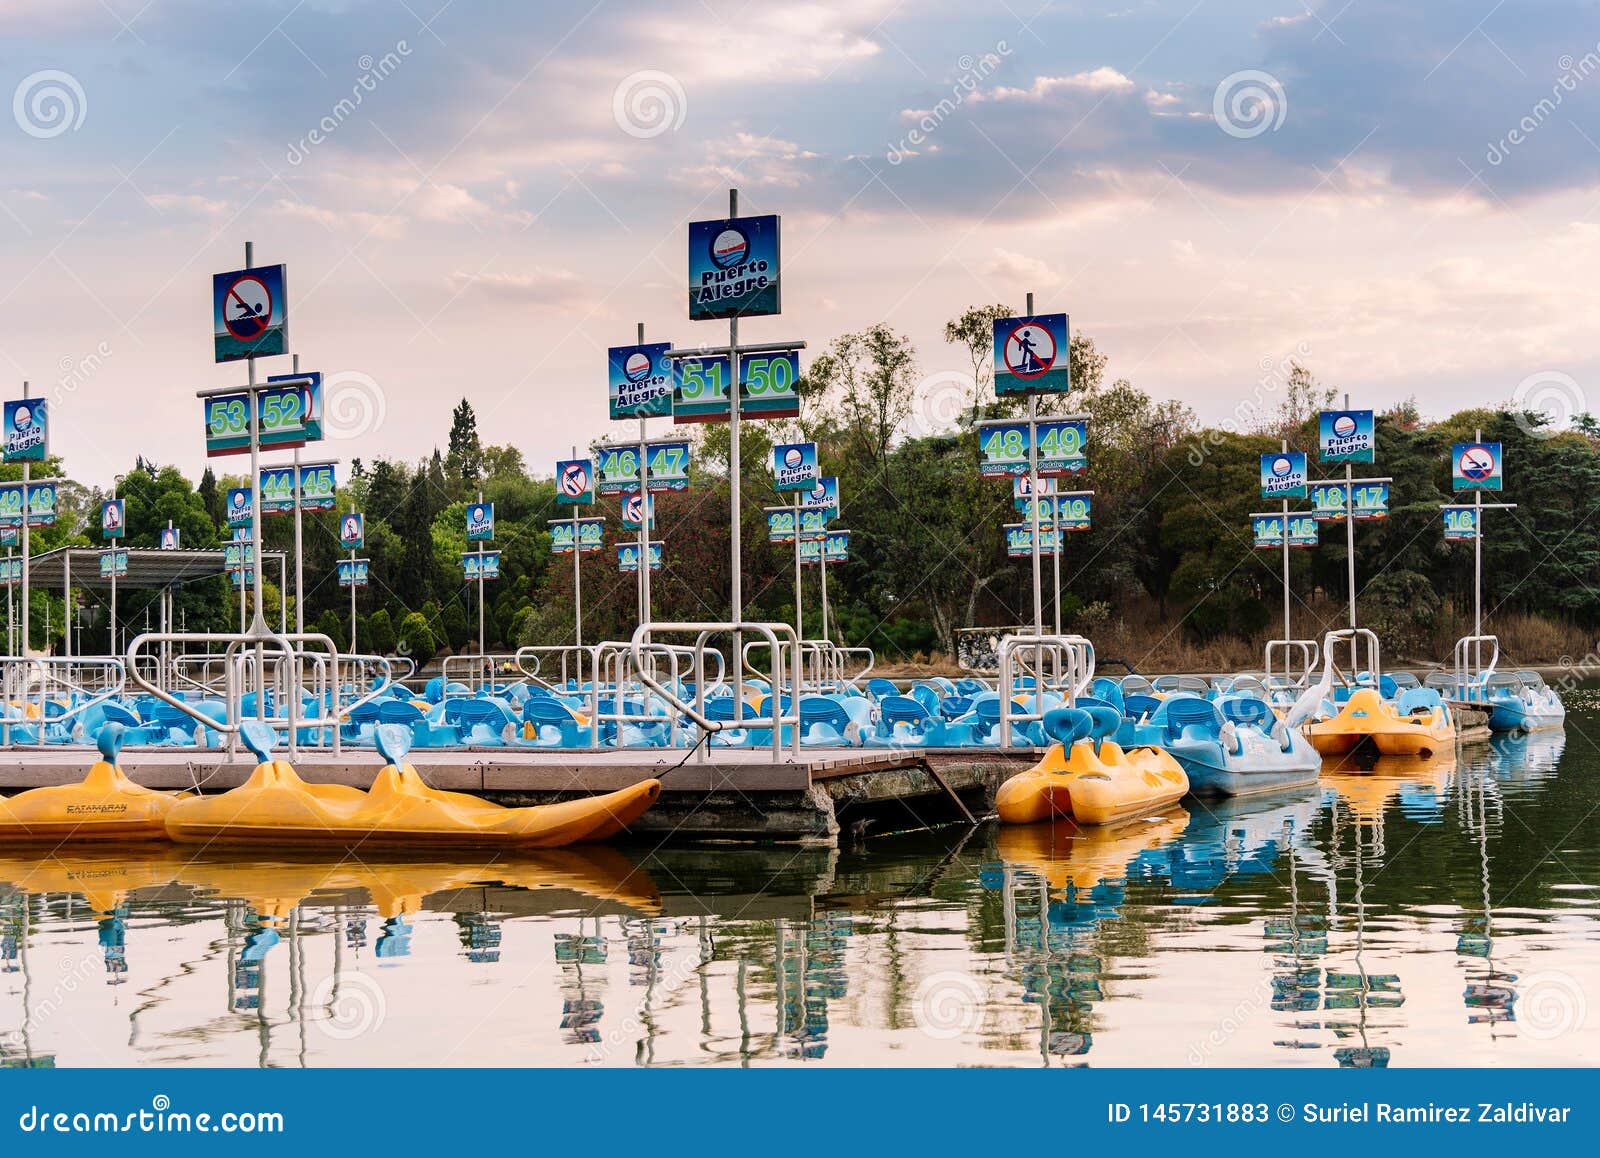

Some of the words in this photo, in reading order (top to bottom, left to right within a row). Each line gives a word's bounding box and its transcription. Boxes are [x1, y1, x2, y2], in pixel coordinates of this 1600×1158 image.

[701, 259, 768, 286] Puerto
[697, 274, 768, 304] Alegre
[617, 374, 665, 395] Puerto
[681, 362, 721, 399] 51
[746, 358, 792, 395] 50
[615, 385, 666, 409] Alegre
[210, 400, 247, 434] 53
[263, 394, 300, 428] 52
[9, 426, 42, 443] Puerto
[985, 430, 1024, 458] 48
[1041, 427, 1080, 456] 49
[1327, 434, 1368, 447] Puerto
[8, 436, 42, 454] Alegre
[1325, 441, 1368, 457] Alegre
[603, 451, 636, 477] 46
[651, 448, 684, 475] 47
[780, 464, 812, 477] Puerto
[263, 473, 291, 498] 44
[302, 470, 332, 496] 45
[779, 472, 812, 486] Alegre
[1266, 479, 1302, 492] Alegre
[1267, 473, 1301, 485] Puerto
[0, 490, 20, 513] 42
[30, 487, 52, 511] 43
[807, 496, 834, 506] Puerto
[1315, 487, 1342, 507] 18
[1356, 487, 1383, 507] 17
[1026, 500, 1050, 519] 20
[1061, 499, 1085, 519] 19
[771, 513, 793, 531] 22
[803, 512, 823, 531] 21
[1257, 520, 1279, 537] 14
[1291, 518, 1313, 536] 15
[1447, 511, 1473, 529] 16
[554, 525, 573, 542] 24
[581, 524, 600, 542] 23
[1010, 530, 1030, 546] 12
[828, 537, 844, 552] 11
[623, 547, 633, 562] 8
